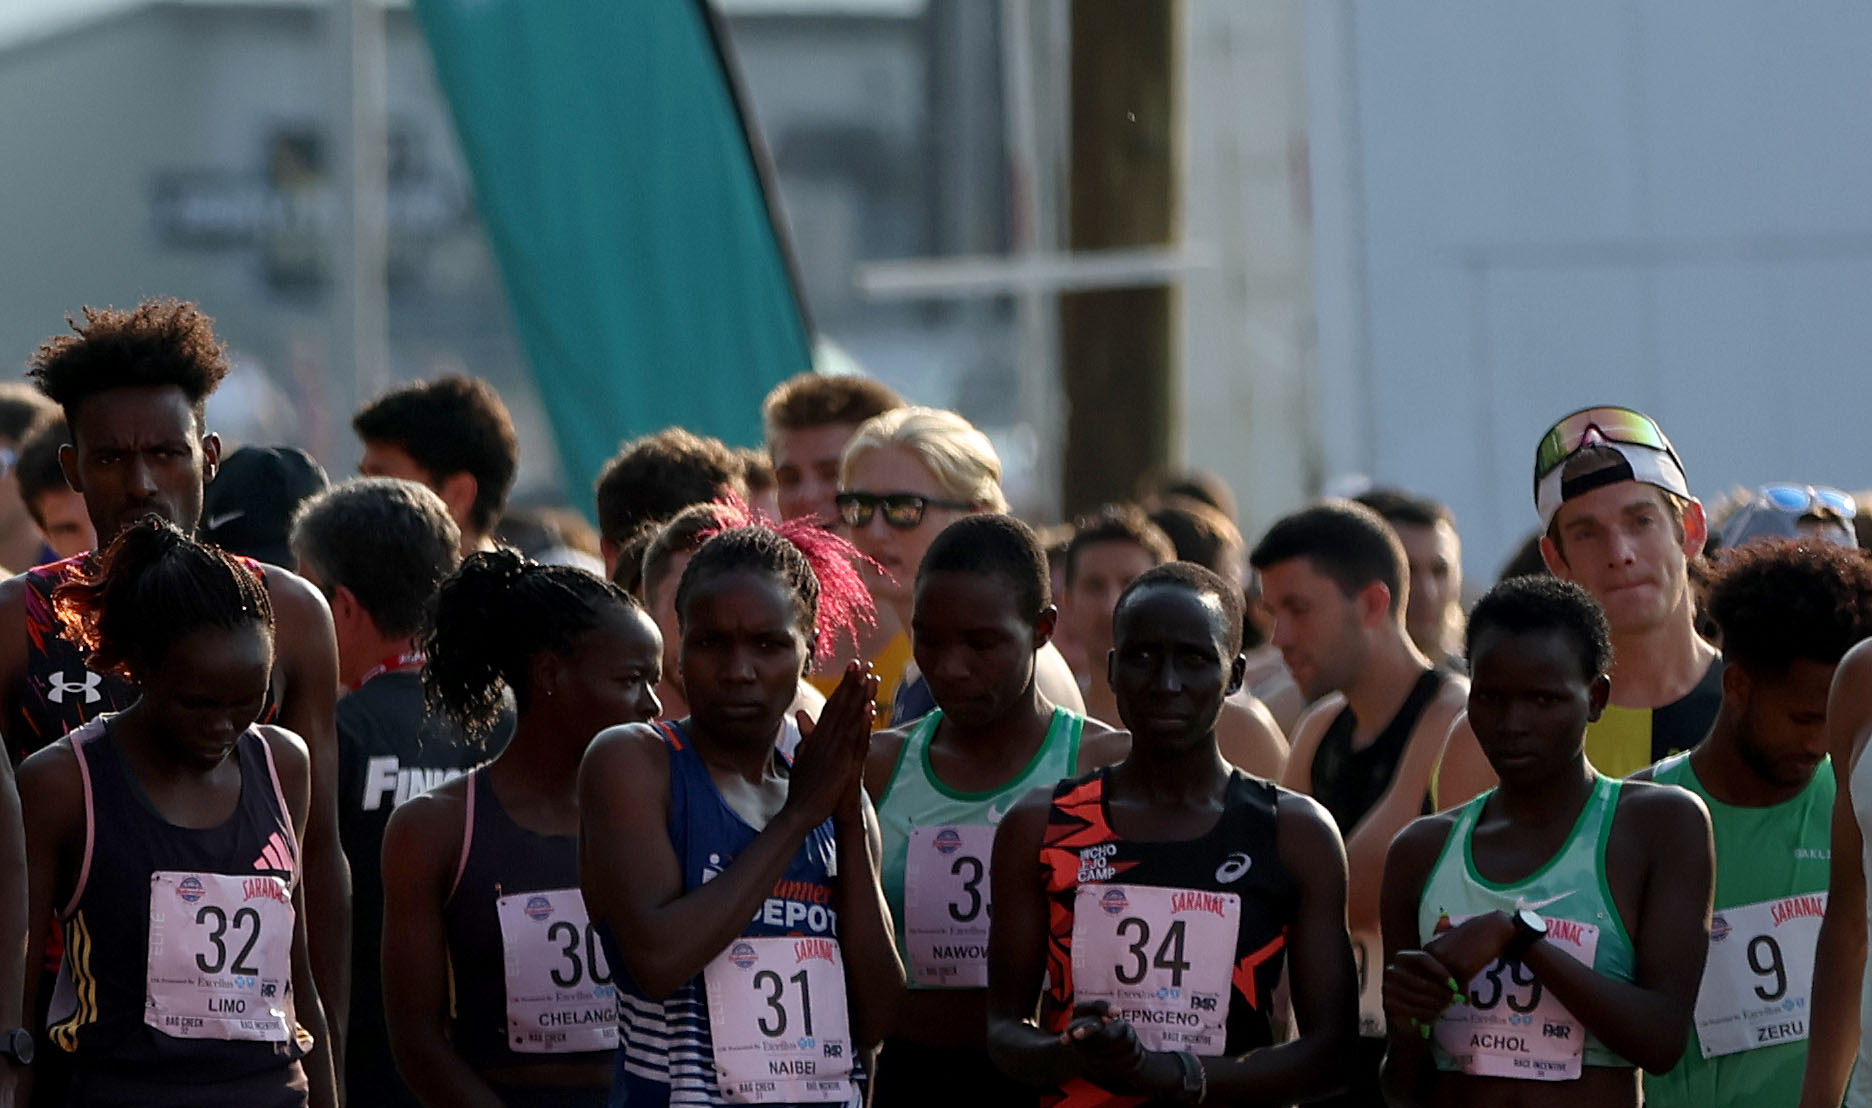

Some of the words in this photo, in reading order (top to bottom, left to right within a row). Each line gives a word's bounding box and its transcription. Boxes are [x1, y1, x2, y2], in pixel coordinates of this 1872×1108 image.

[1078, 867, 1116, 882] CAMP
[242, 877, 288, 904] SARANAC
[948, 856, 993, 923] 3
[1171, 891, 1225, 918] SARANAC
[1770, 897, 1825, 928] SARANAC
[195, 905, 261, 976] 32
[1545, 919, 1584, 946] RANAC
[548, 921, 613, 988] 30
[794, 939, 836, 964] SARANAC
[1114, 917, 1191, 987] 34
[1747, 934, 1788, 1002] 9
[197, 976, 234, 988] Excellus
[1470, 956, 1543, 1014] 39
[208, 998, 246, 1014] LIMO
[753, 969, 813, 1037] 31
[1118, 1007, 1199, 1027] EPNGENO
[1470, 1033, 1530, 1052] ACHOL
[1758, 1020, 1804, 1042] ZERU
[769, 1061, 816, 1075] NAIBEI
